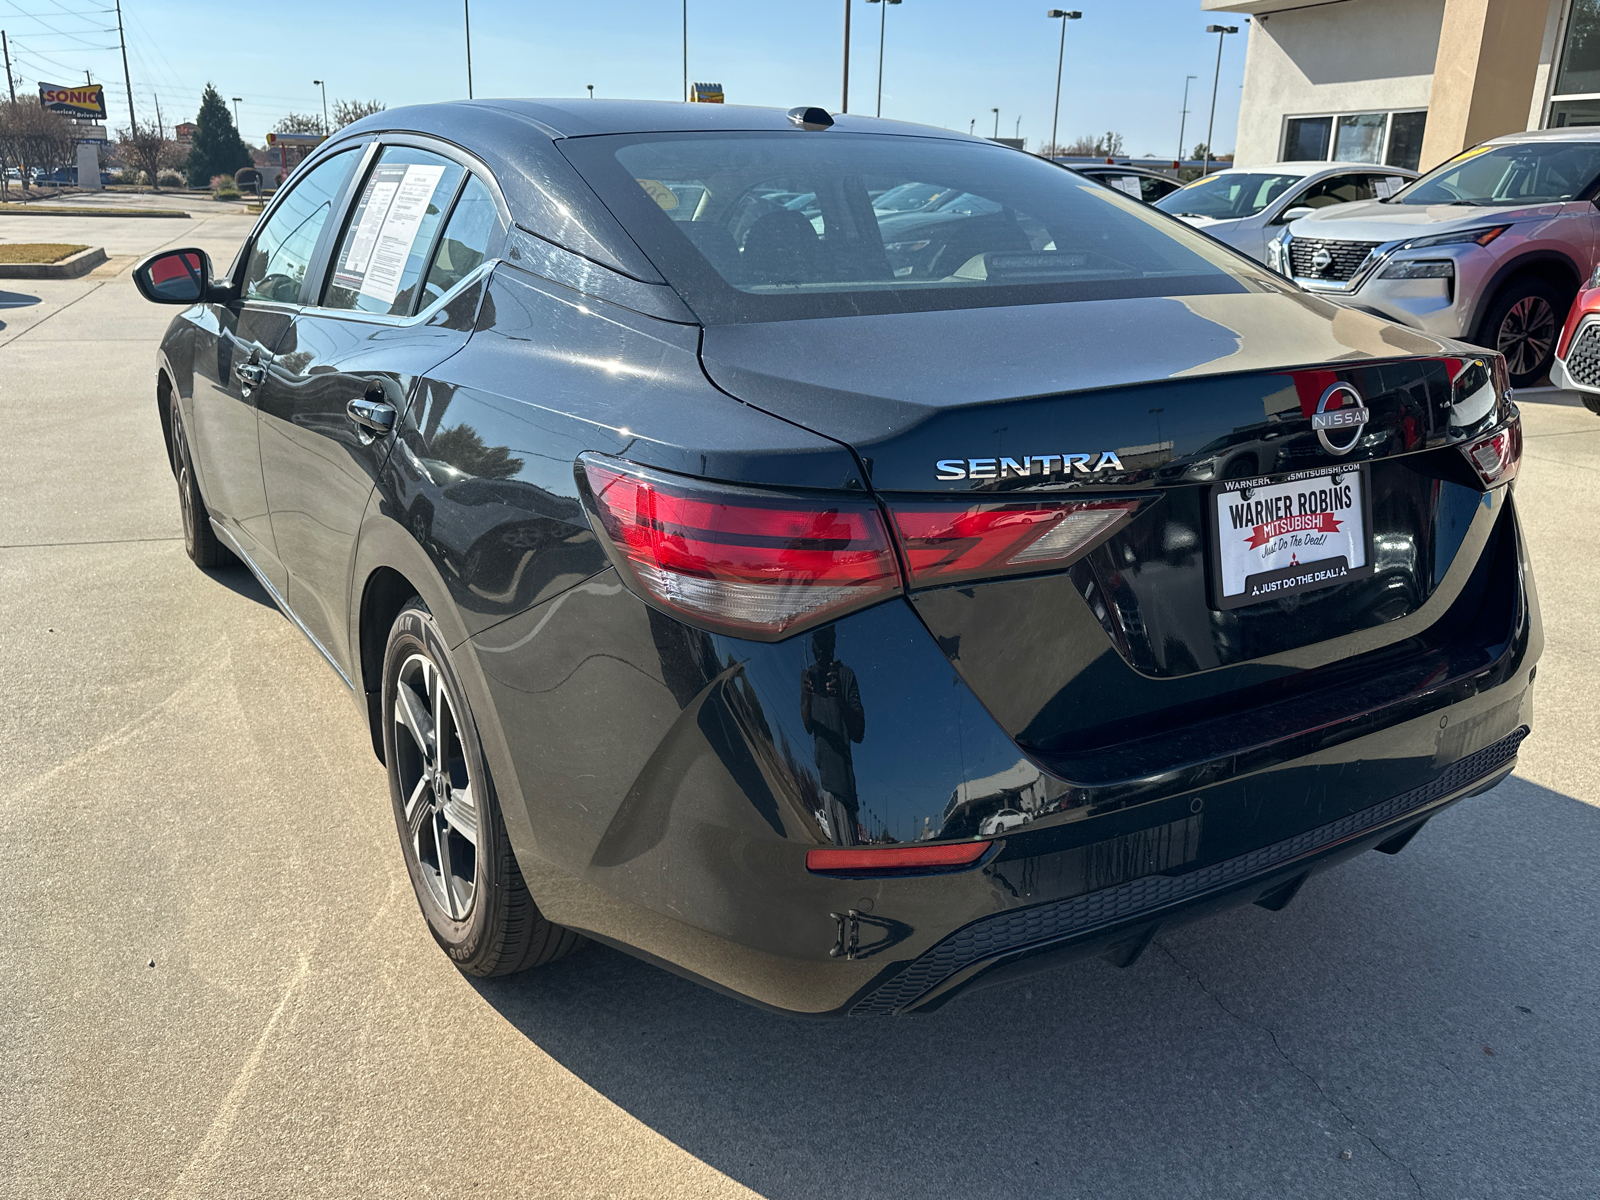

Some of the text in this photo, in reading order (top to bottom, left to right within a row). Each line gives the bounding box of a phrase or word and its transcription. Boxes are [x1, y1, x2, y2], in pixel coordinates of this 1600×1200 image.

[46, 90, 97, 104] SONIC
[1314, 410, 1369, 427] NISSAN
[935, 451, 1125, 481] SENTRA
[1228, 485, 1352, 530] WARNER ROBINS
[1262, 515, 1324, 539] MITSUBISHI
[1261, 533, 1328, 558] Just Do The Deal!
[1260, 568, 1339, 594] JUST DO THE DEAL!
